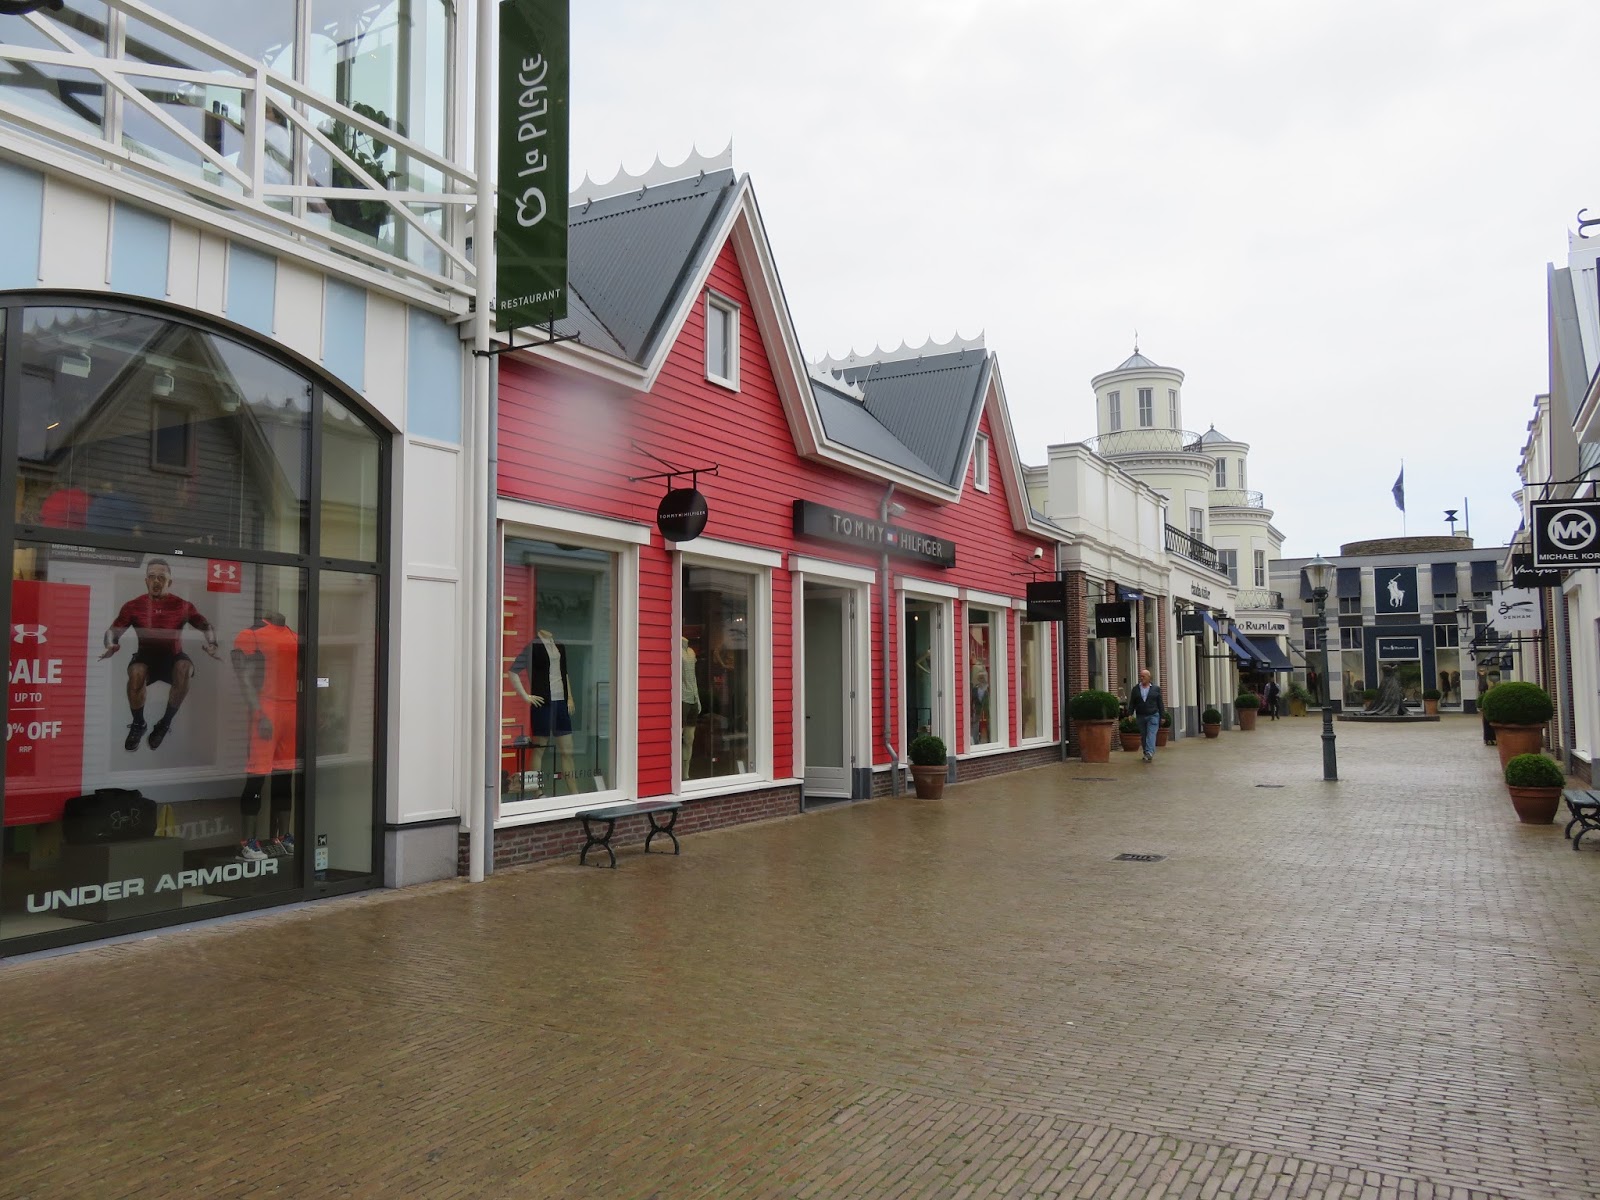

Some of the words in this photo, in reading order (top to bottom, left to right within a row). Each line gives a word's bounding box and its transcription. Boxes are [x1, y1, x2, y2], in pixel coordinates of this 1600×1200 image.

[517, 53, 548, 142] PLACE
[500, 288, 561, 310] RESTAURANT
[833, 514, 884, 543] TOMMY
[901, 532, 943, 558] HILFIGER
[1245, 621, 1267, 630] RALPH
[14, 692, 28, 703] UP
[29, 692, 42, 703] TO
[27, 720, 63, 740] OFF
[18, 745, 33, 753] RRP
[26, 877, 145, 914] UNDER
[153, 857, 279, 893] ARMOUR
